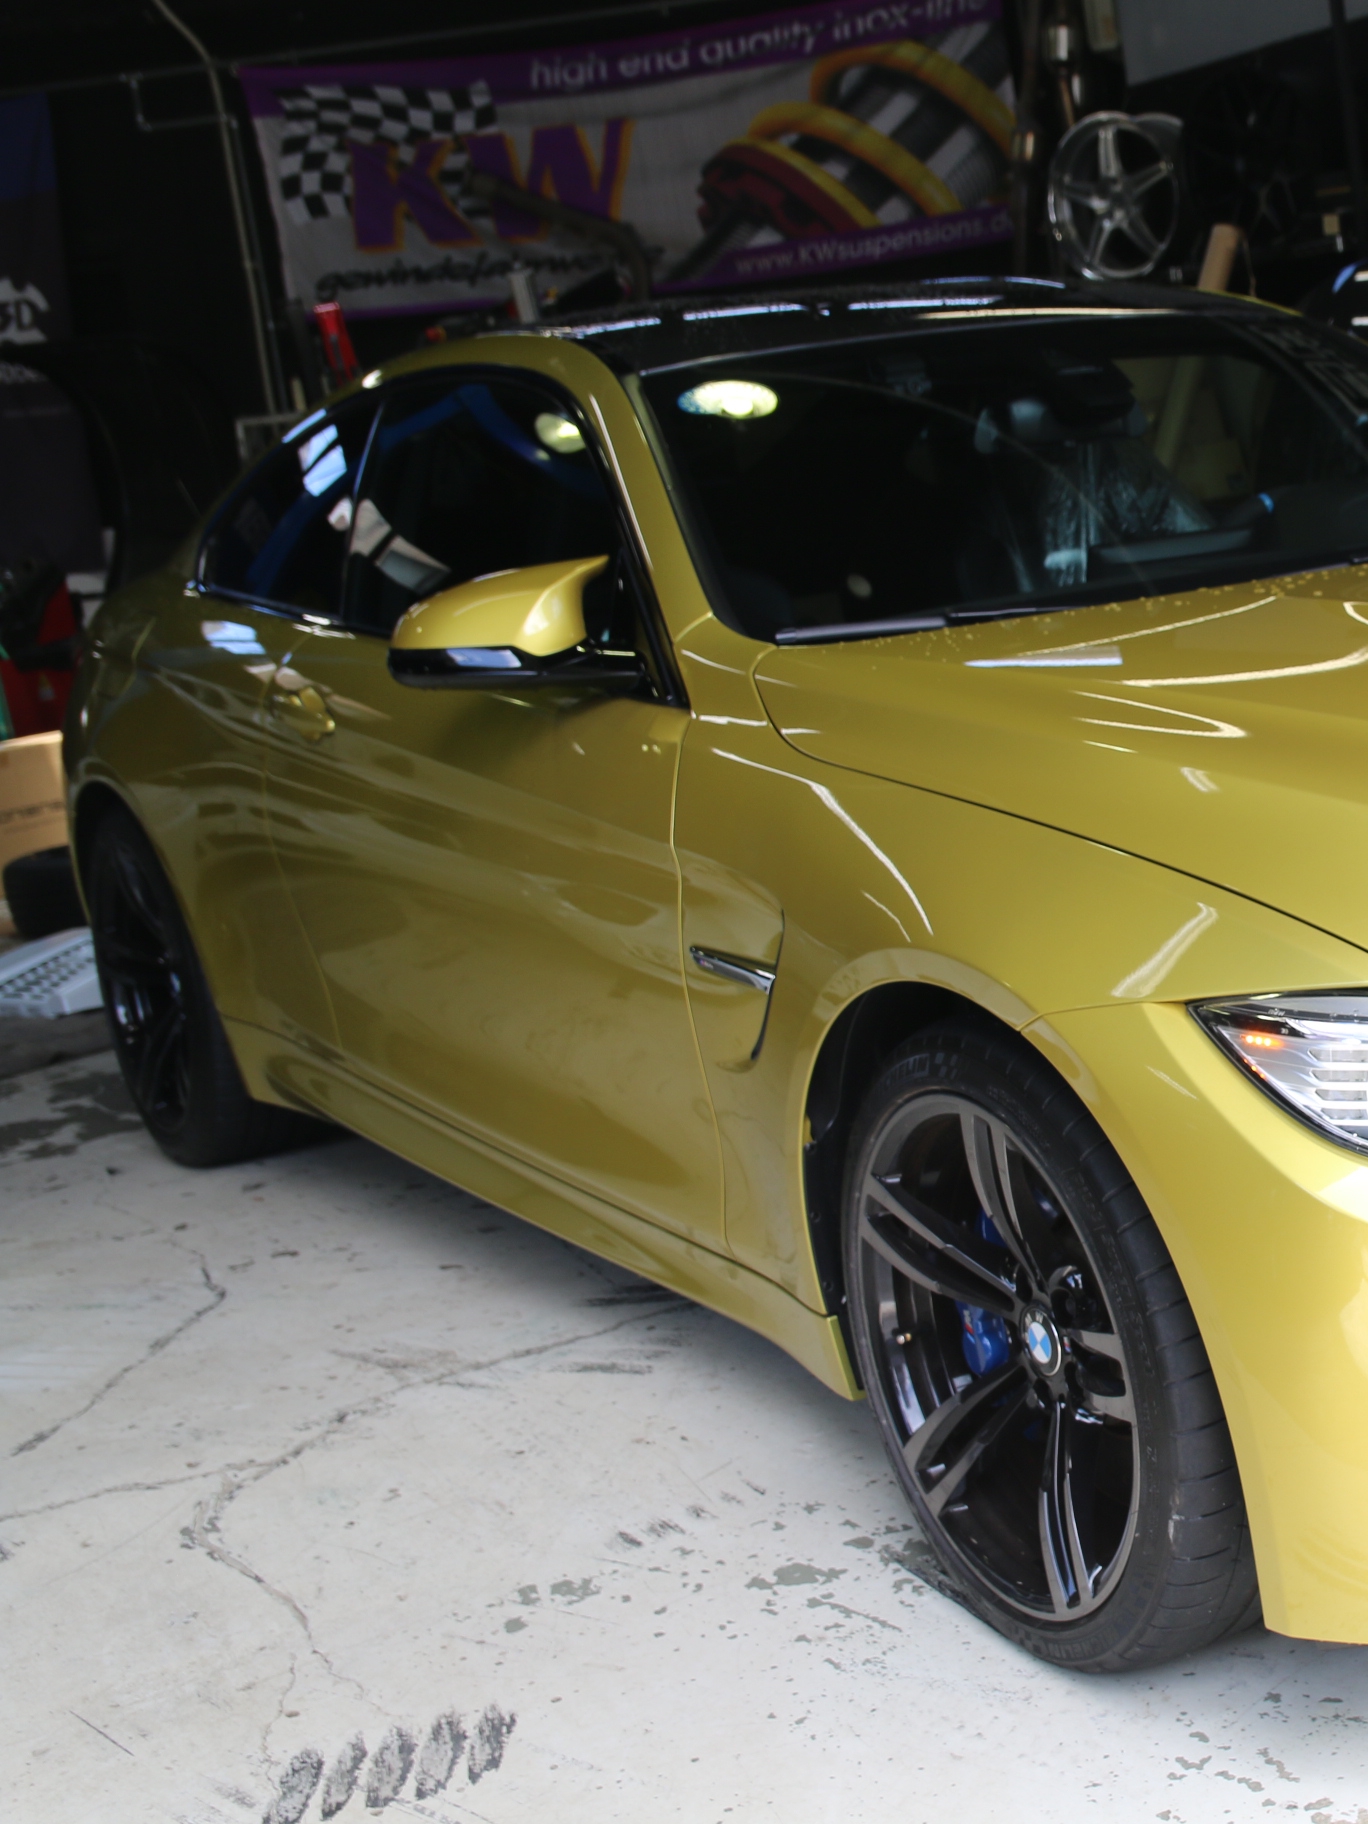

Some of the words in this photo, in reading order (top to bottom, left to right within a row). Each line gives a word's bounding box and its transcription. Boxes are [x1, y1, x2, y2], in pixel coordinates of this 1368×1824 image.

[529, 51, 609, 93] high
[616, 38, 692, 79] end
[697, 21, 826, 68] quality
[344, 117, 638, 254] KW
[733, 209, 1014, 277] www.KWsuspensions.d
